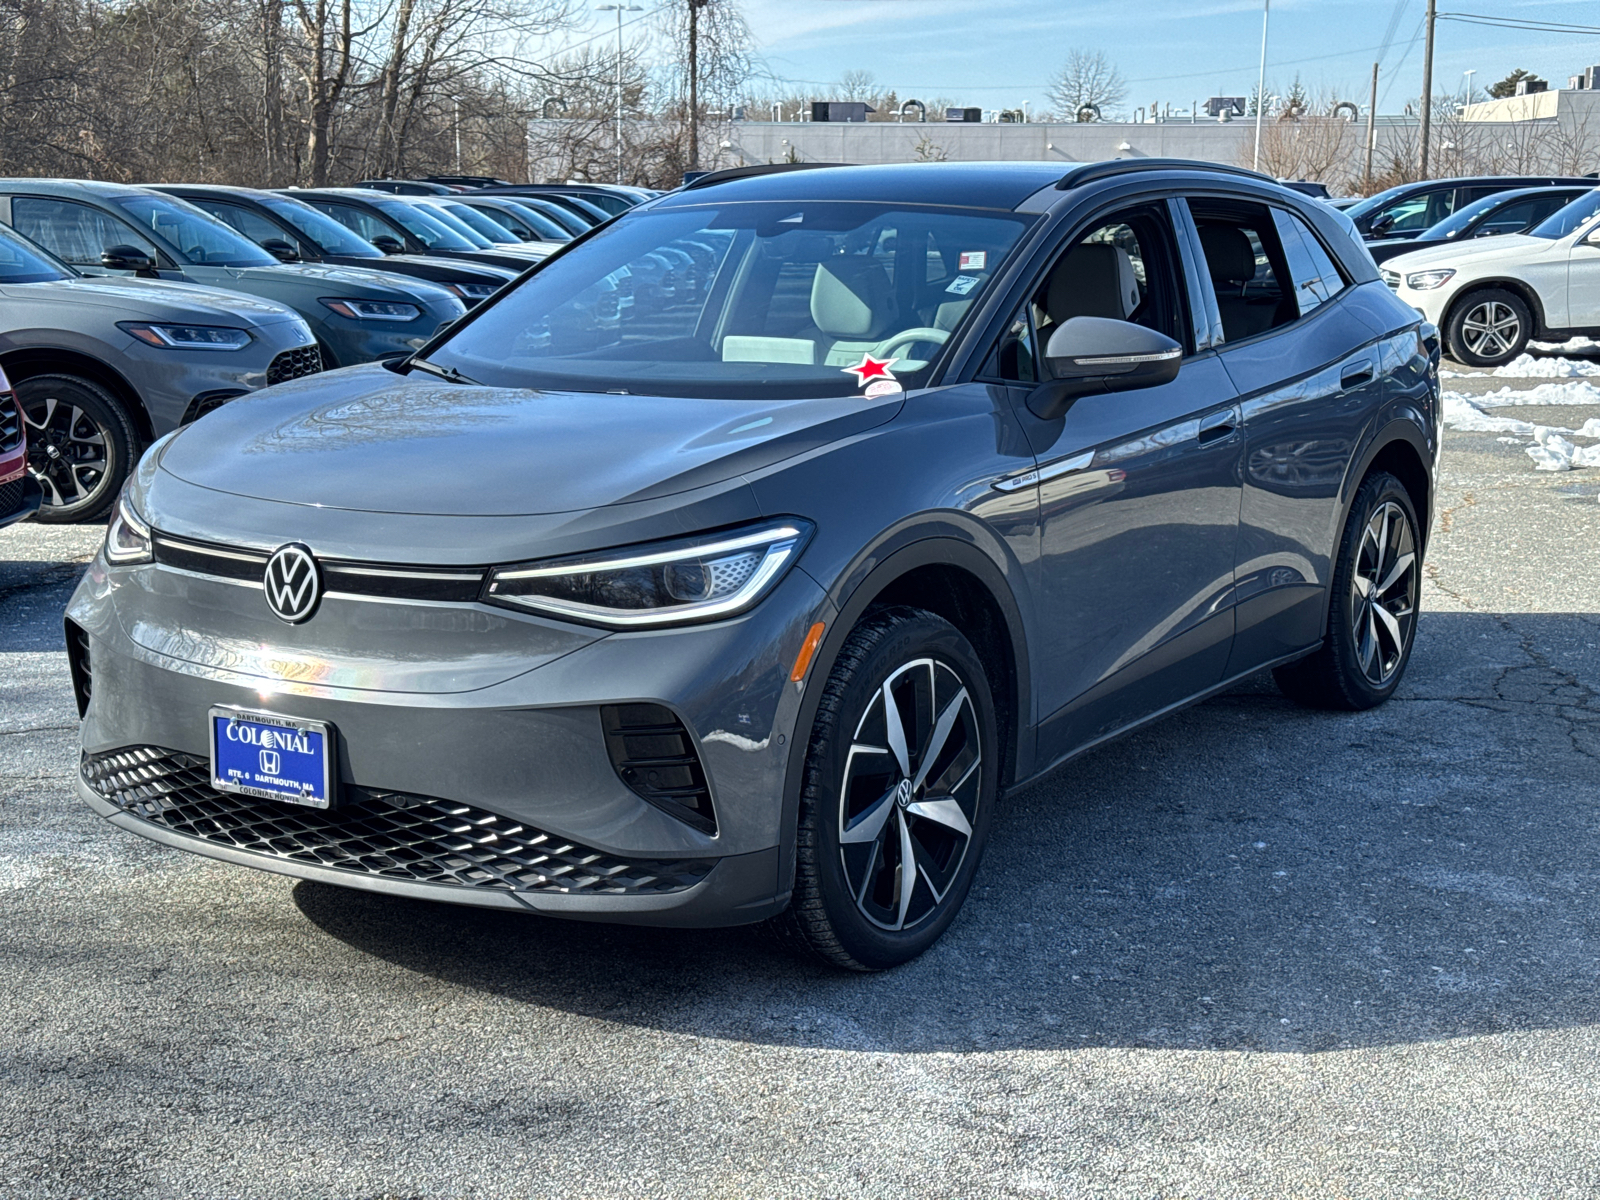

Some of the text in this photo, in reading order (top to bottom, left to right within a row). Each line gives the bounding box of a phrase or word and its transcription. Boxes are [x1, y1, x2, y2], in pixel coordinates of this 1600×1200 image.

[266, 550, 316, 614] VW
[236, 713, 284, 727] DARTMOUTH,
[226, 722, 314, 755] COLONIAL
[228, 768, 314, 792] RTE. 6 DARTMOUTH, MA
[239, 786, 273, 799] COLONIAL
